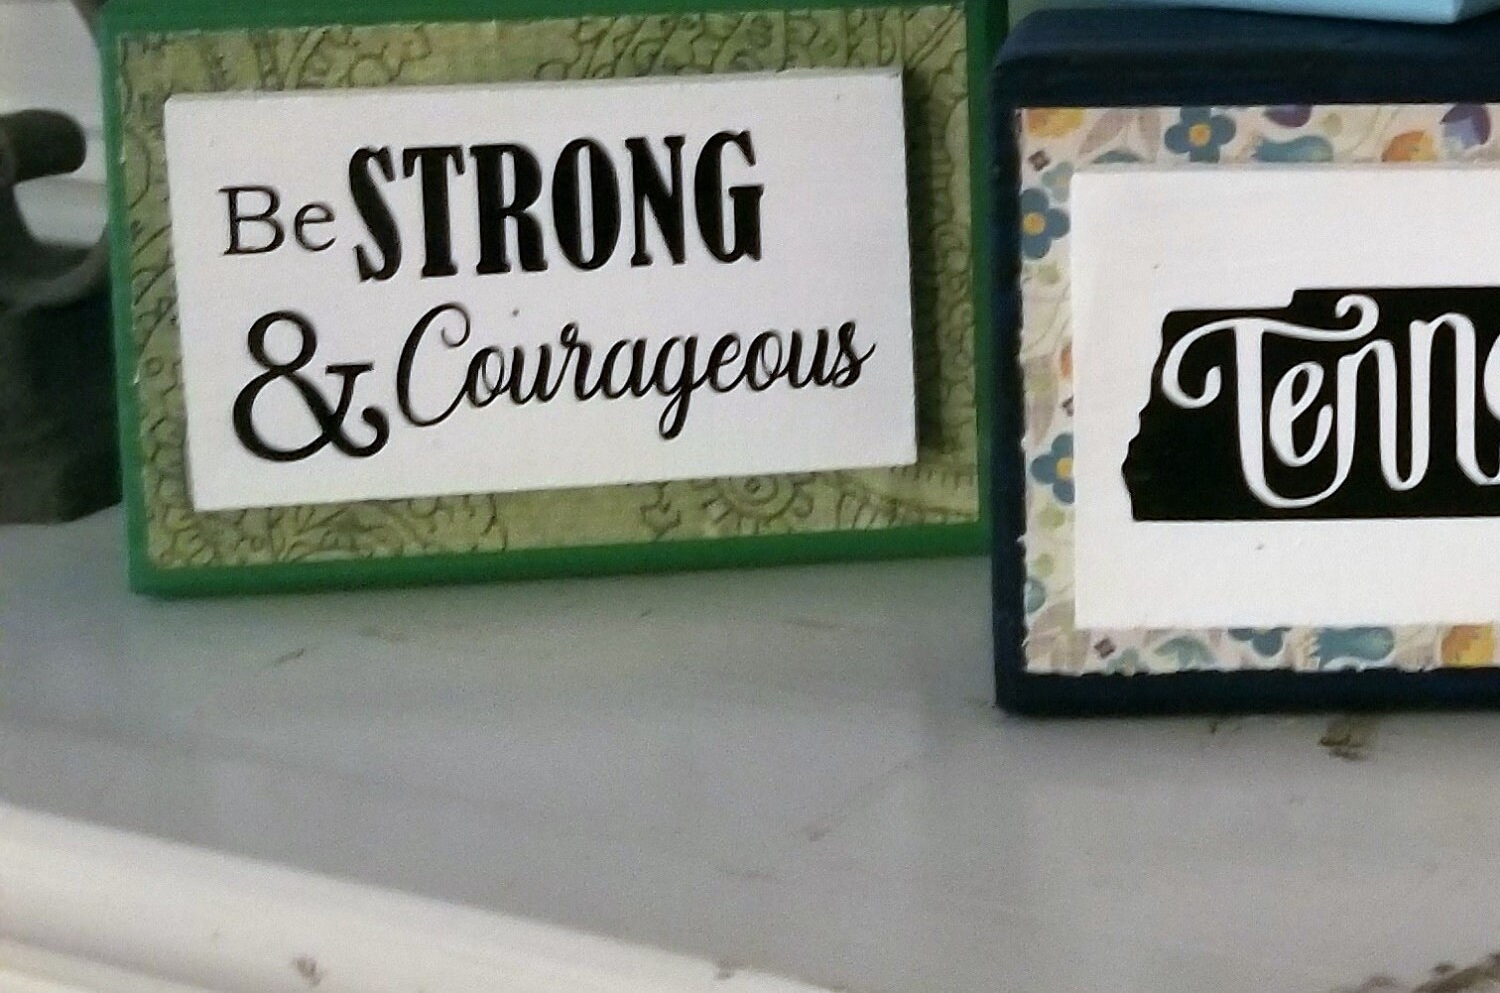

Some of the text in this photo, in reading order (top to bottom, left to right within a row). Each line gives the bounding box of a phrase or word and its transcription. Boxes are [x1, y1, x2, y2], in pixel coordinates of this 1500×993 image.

[217, 129, 766, 284] Be STRONG
[231, 302, 878, 463] & Courageous
